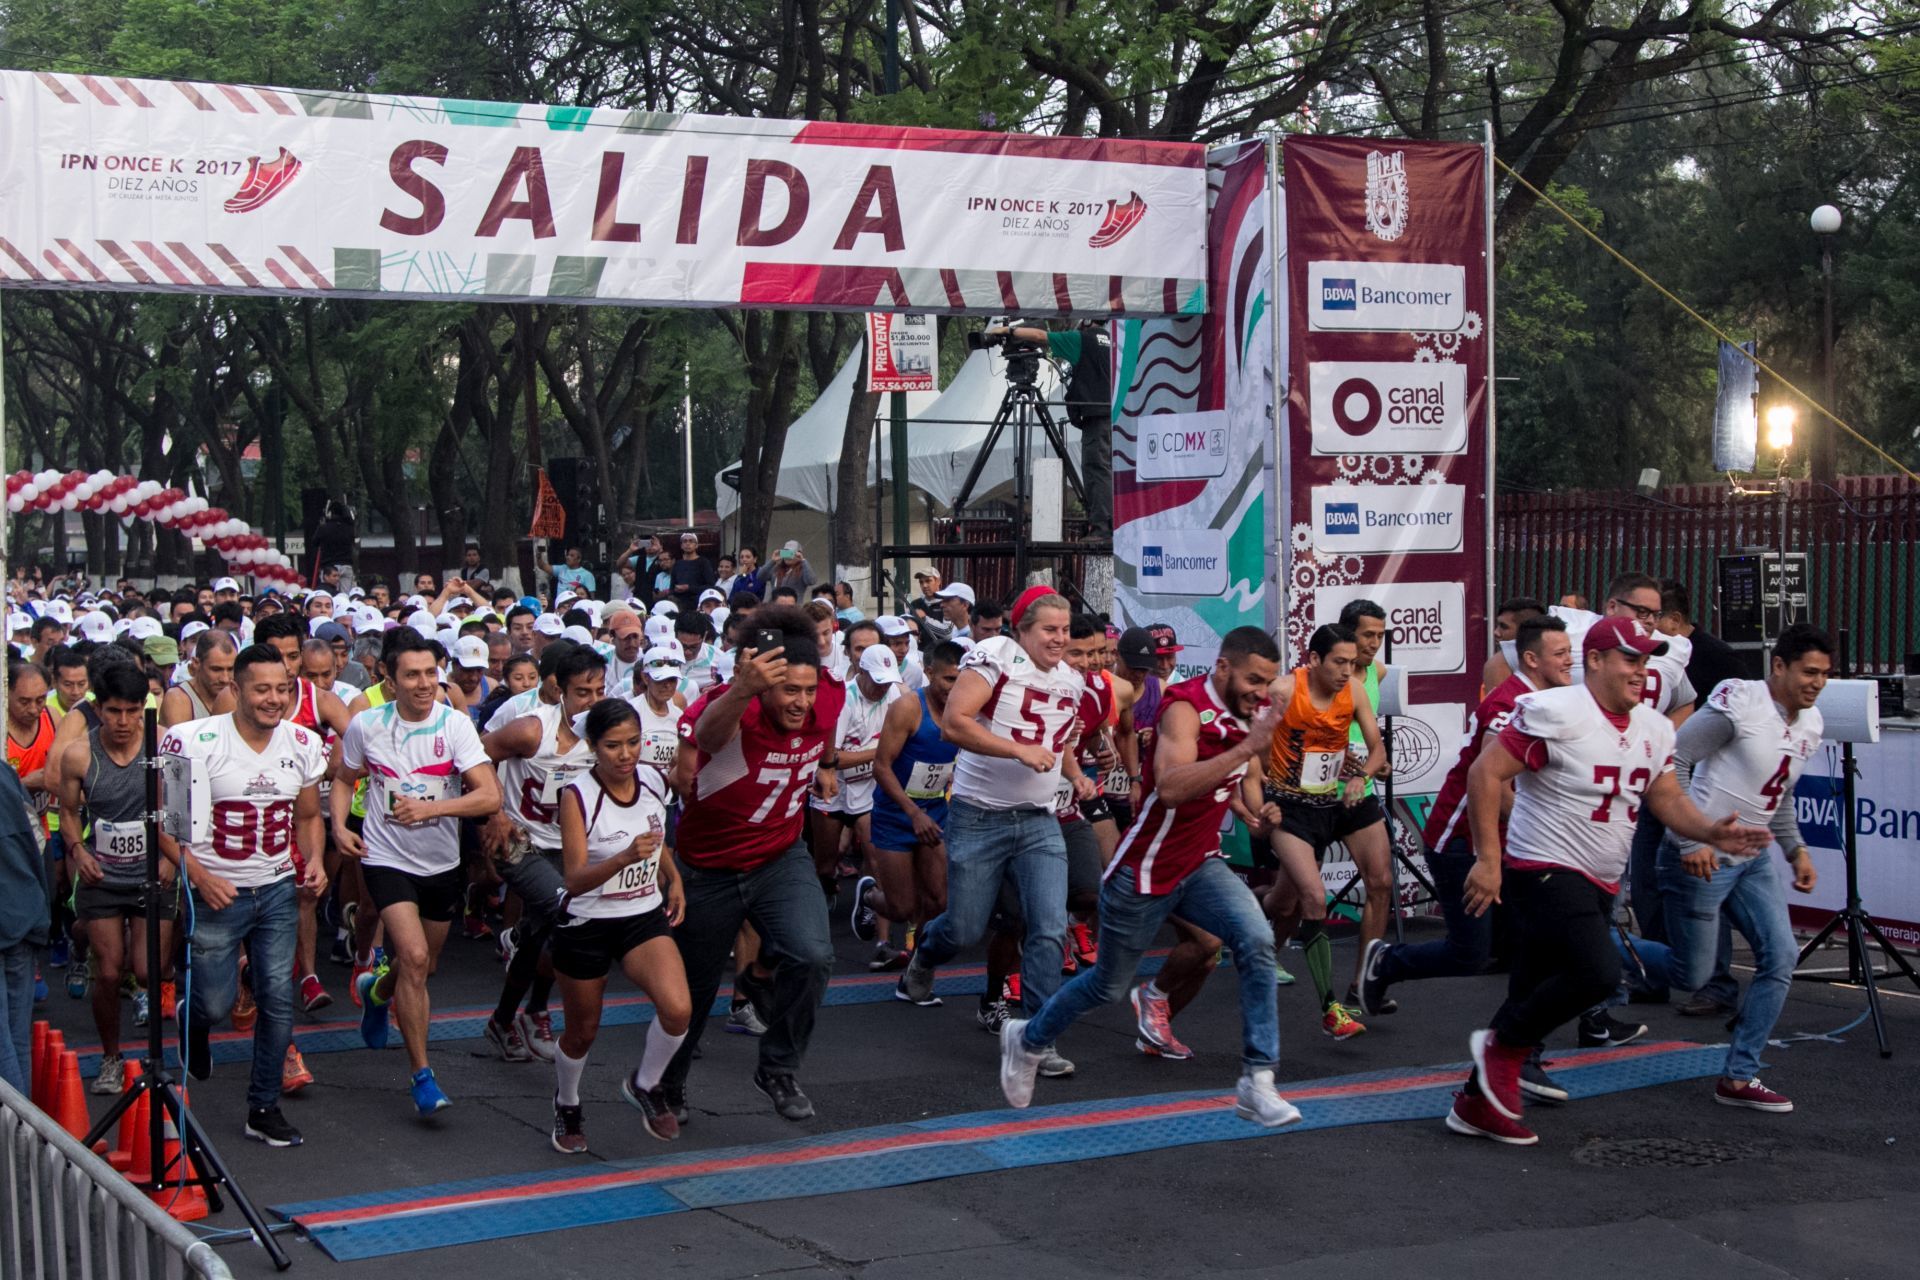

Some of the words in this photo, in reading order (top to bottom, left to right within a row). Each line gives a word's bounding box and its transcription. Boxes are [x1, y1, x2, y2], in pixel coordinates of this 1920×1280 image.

[61, 154, 97, 170] IPN
[104, 156, 163, 173] ONCE
[170, 158, 184, 173] K
[196, 160, 242, 175] 2017
[108, 177, 143, 191] DIEZ
[150, 176, 198, 193] AÑOS
[379, 139, 906, 252] SALIDA
[967, 197, 996, 211] IPN
[1000, 199, 1044, 213] ONCE
[1049, 201, 1059, 214] K
[1068, 202, 1103, 216] 2017
[1002, 217, 1029, 229] DIEZ
[1034, 216, 1070, 231] AÑOS
[1323, 288, 1355, 301] BBVA
[1362, 287, 1452, 305] Bancomer
[872, 381, 932, 391] 55.56.90.49
[1388, 381, 1444, 406] canal
[1388, 406, 1444, 424] once
[1162, 431, 1206, 452] CDMX
[1326, 512, 1359, 525] BBVA
[1365, 510, 1453, 527] Bancomer
[1143, 555, 1163, 567] BBVA
[1165, 554, 1218, 570] Bancomer
[1390, 600, 1442, 625] canal
[1391, 625, 1443, 645] once
[1011, 687, 1074, 753] 52
[748, 759, 819, 824] 72
[924, 774, 940, 789] 27
[1111, 776, 1130, 792] 131
[1760, 755, 1792, 811] 4
[1590, 765, 1651, 823] 73
[212, 800, 292, 861] 88
[110, 835, 144, 855] 4385
[618, 862, 656, 889] 10367
